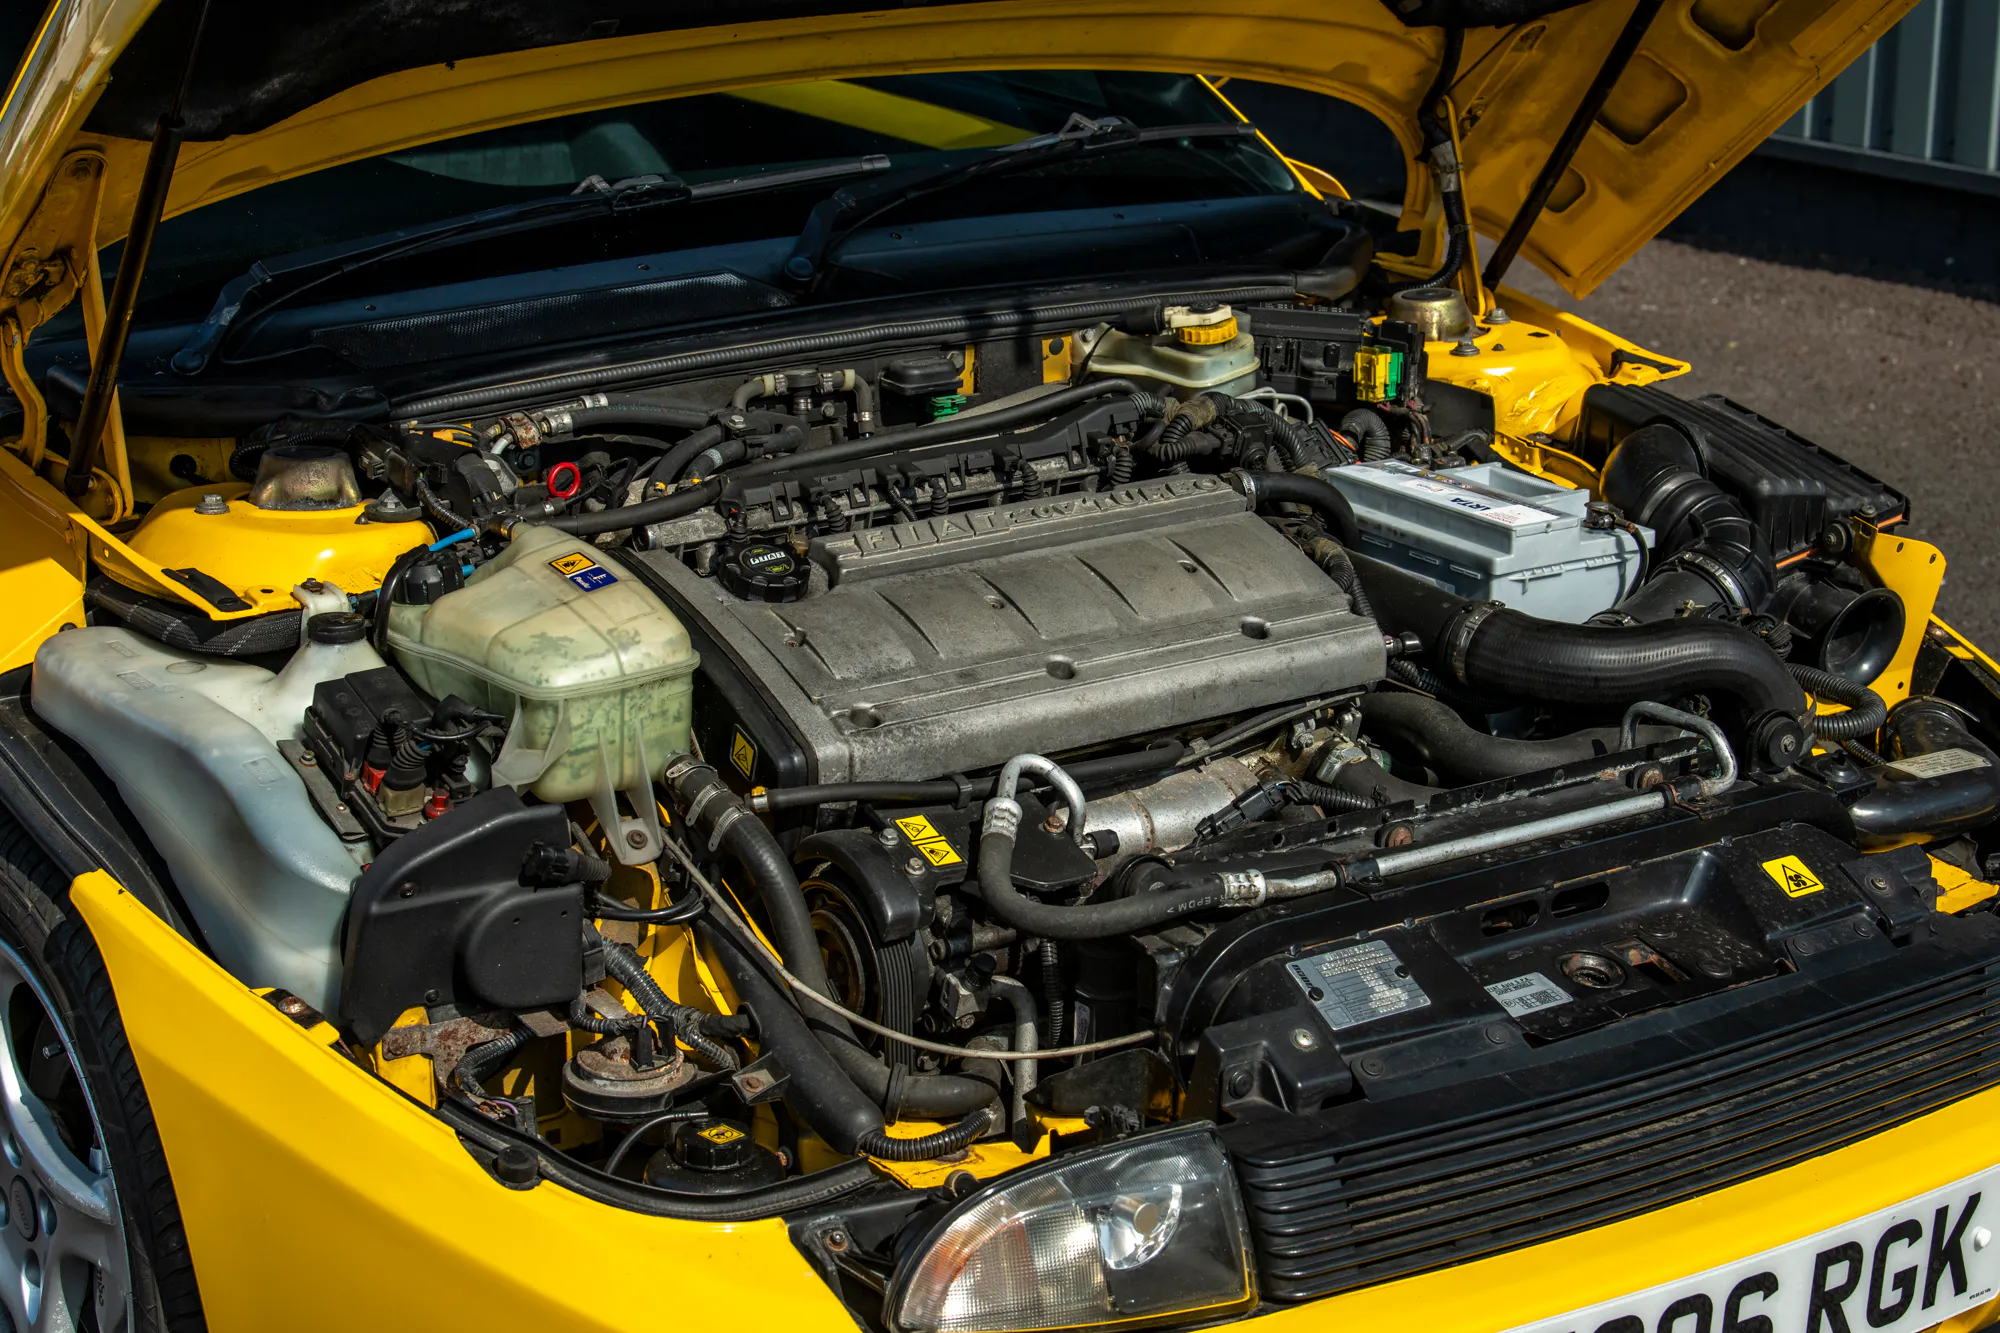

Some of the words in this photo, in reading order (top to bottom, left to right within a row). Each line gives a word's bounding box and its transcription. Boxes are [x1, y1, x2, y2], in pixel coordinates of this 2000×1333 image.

[865, 510, 997, 549] FIAT
[749, 551, 786, 565] FIAT
[1805, 1191, 1982, 1333] RGK
